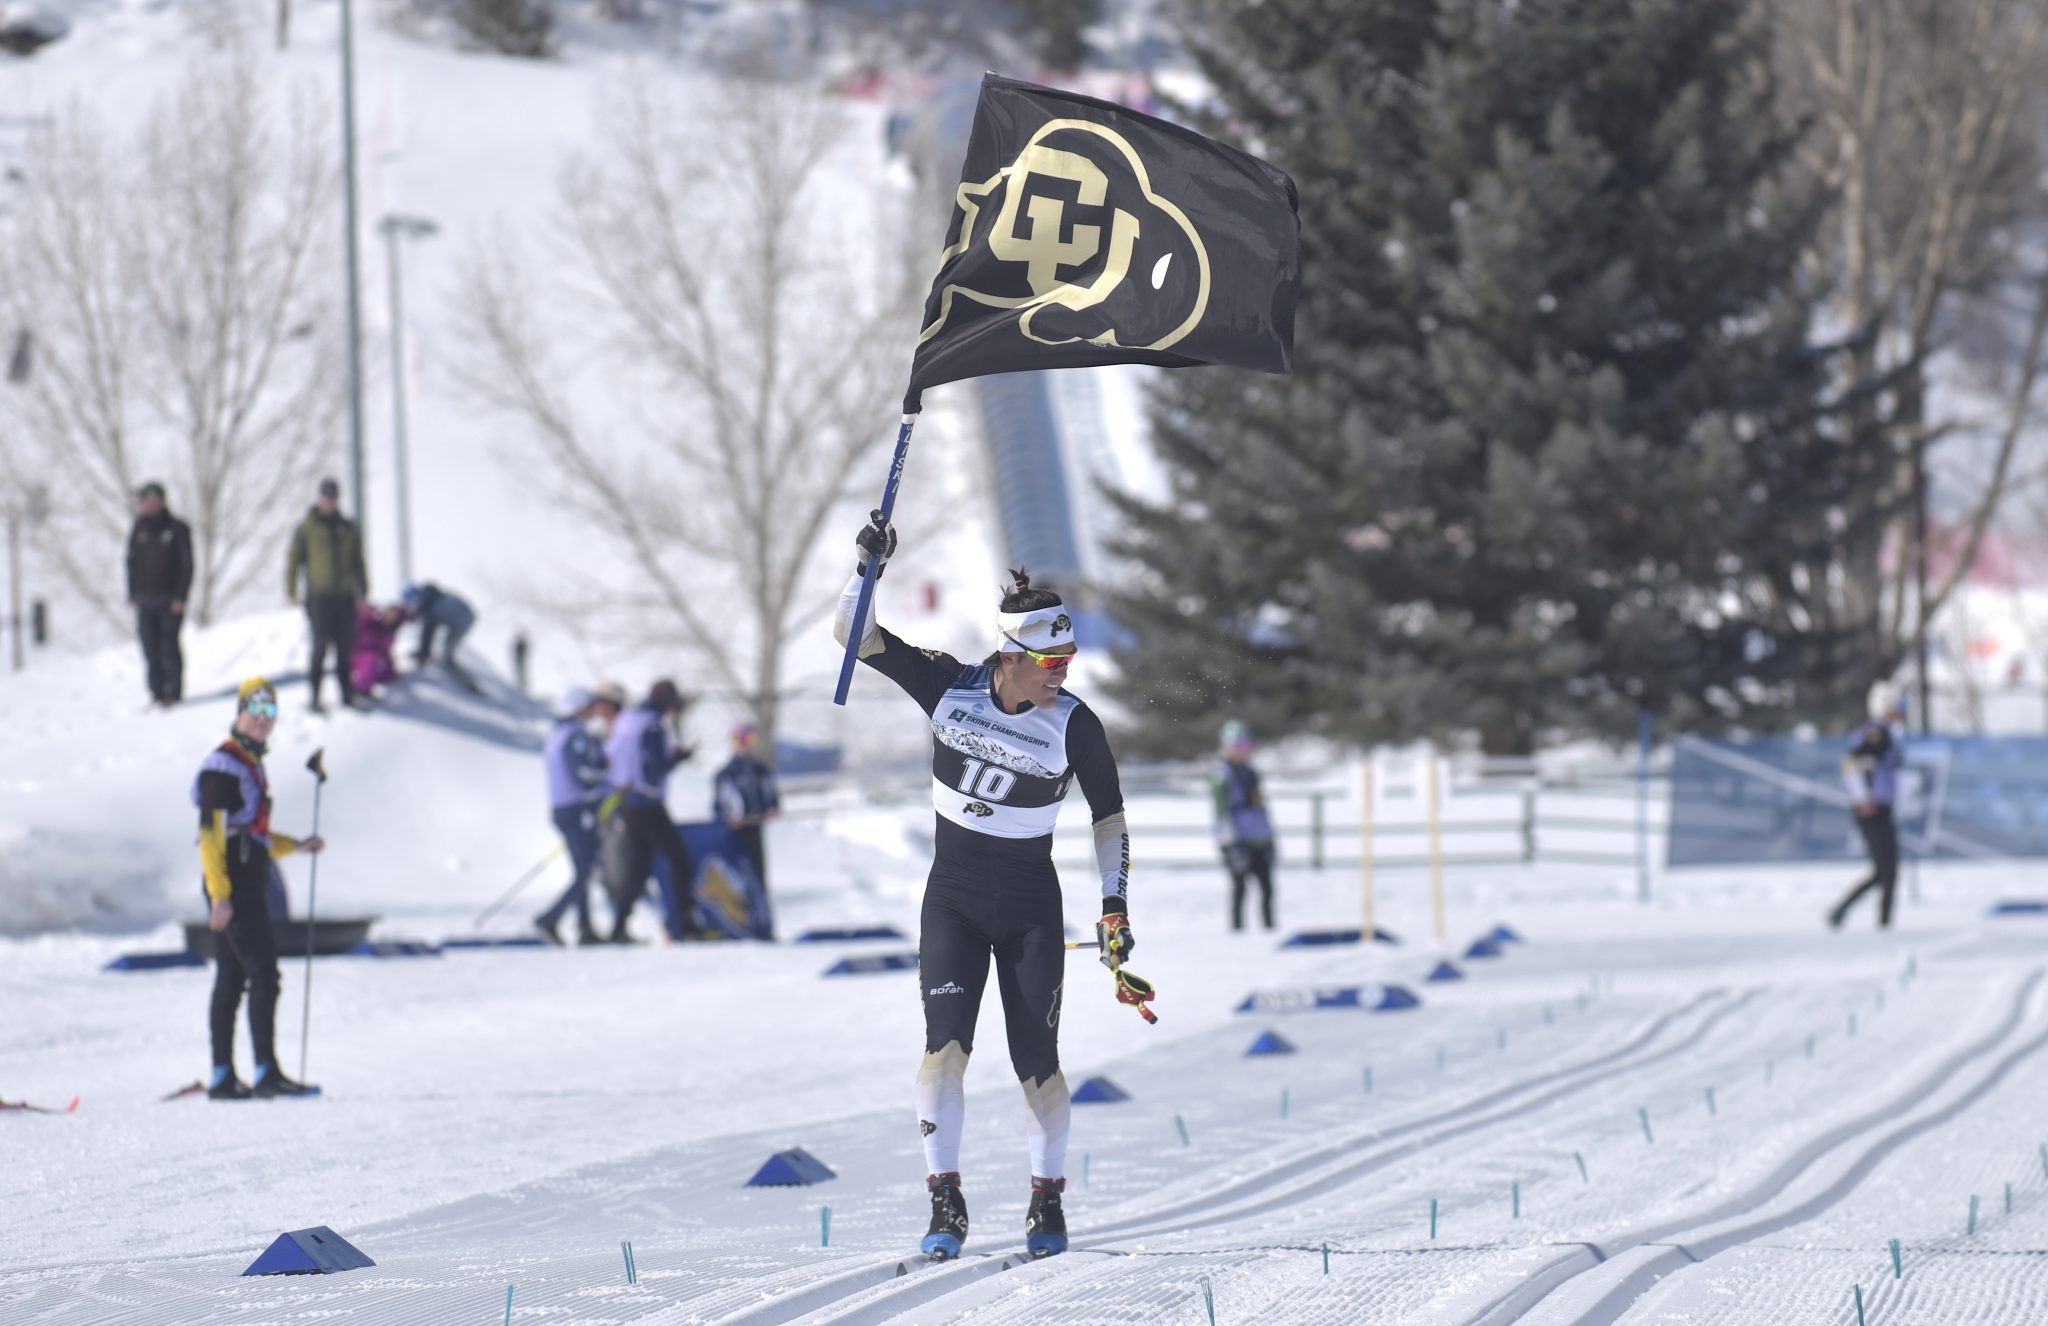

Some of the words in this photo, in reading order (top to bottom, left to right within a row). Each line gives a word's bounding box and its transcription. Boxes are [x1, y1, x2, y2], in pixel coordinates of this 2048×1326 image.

[965, 715, 991, 728] SKIING
[990, 723, 1050, 749] CHAMPIONSHIPS
[957, 757, 1018, 801] 10
